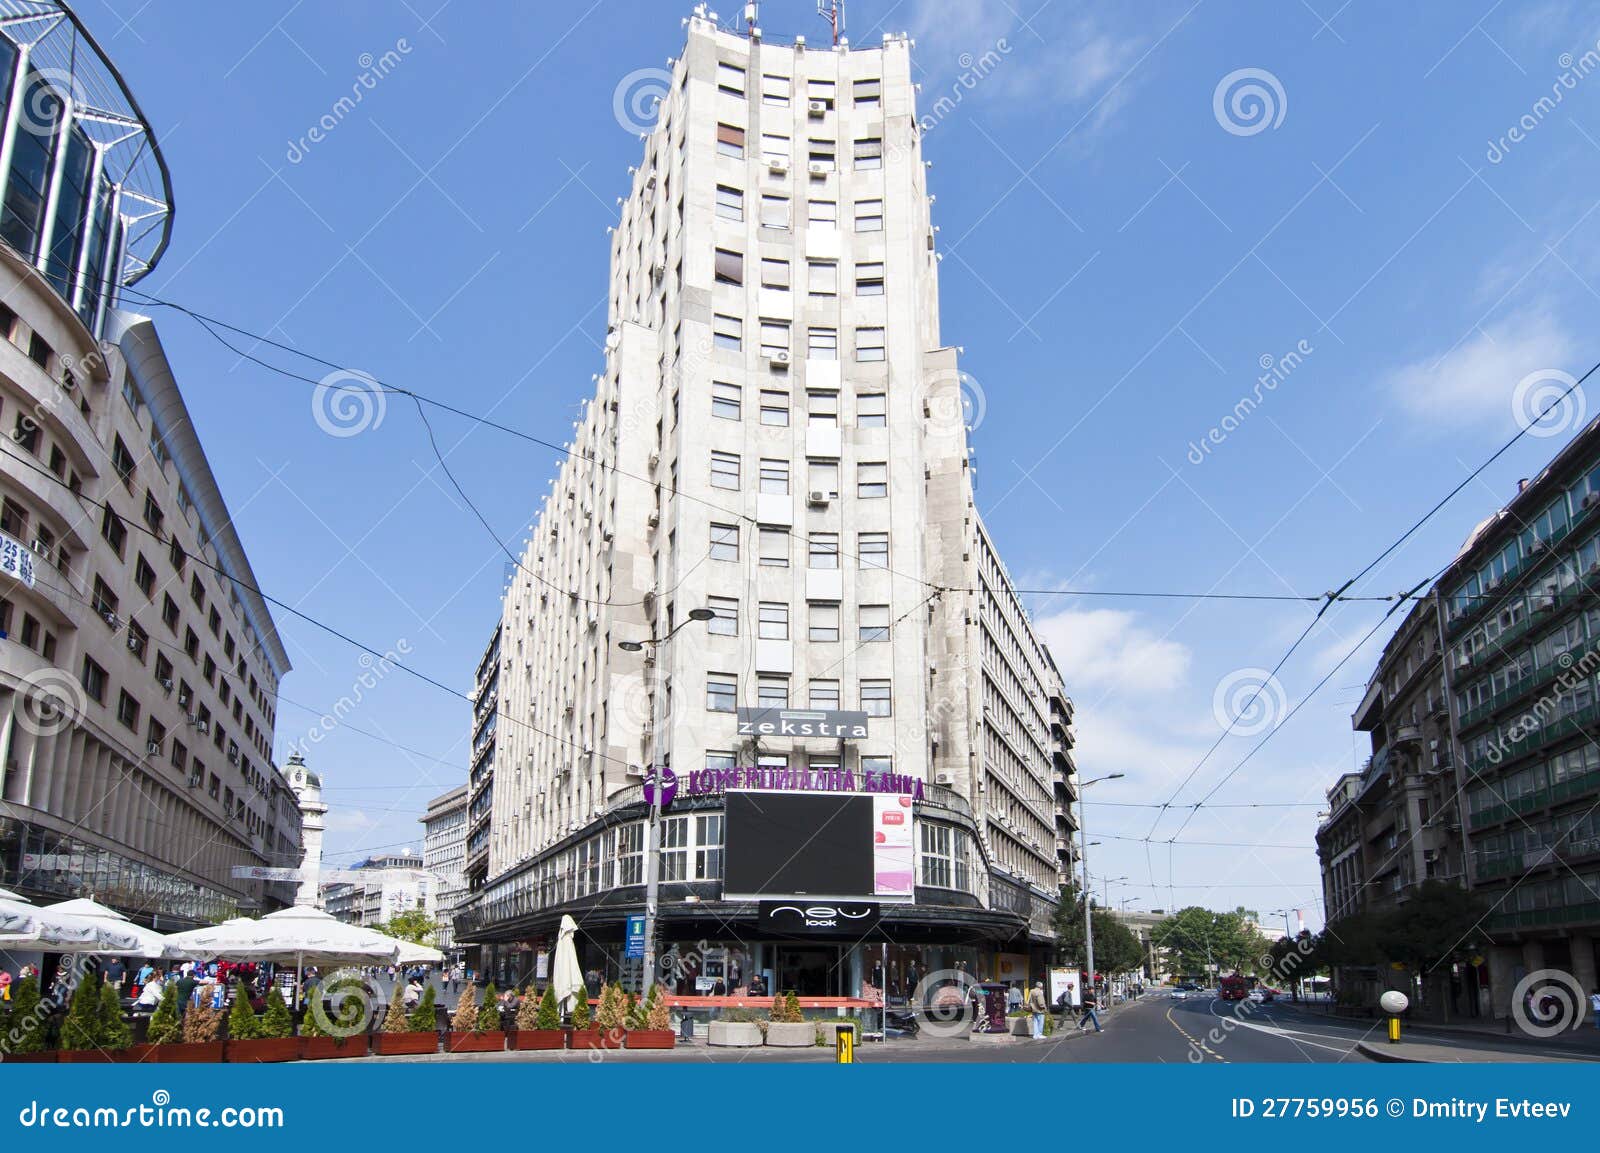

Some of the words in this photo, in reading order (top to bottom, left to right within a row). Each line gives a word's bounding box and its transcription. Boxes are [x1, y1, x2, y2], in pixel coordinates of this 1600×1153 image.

[739, 719, 867, 737] zekstra
[865, 770, 926, 800] БАНКА
[805, 918, 838, 927] look
